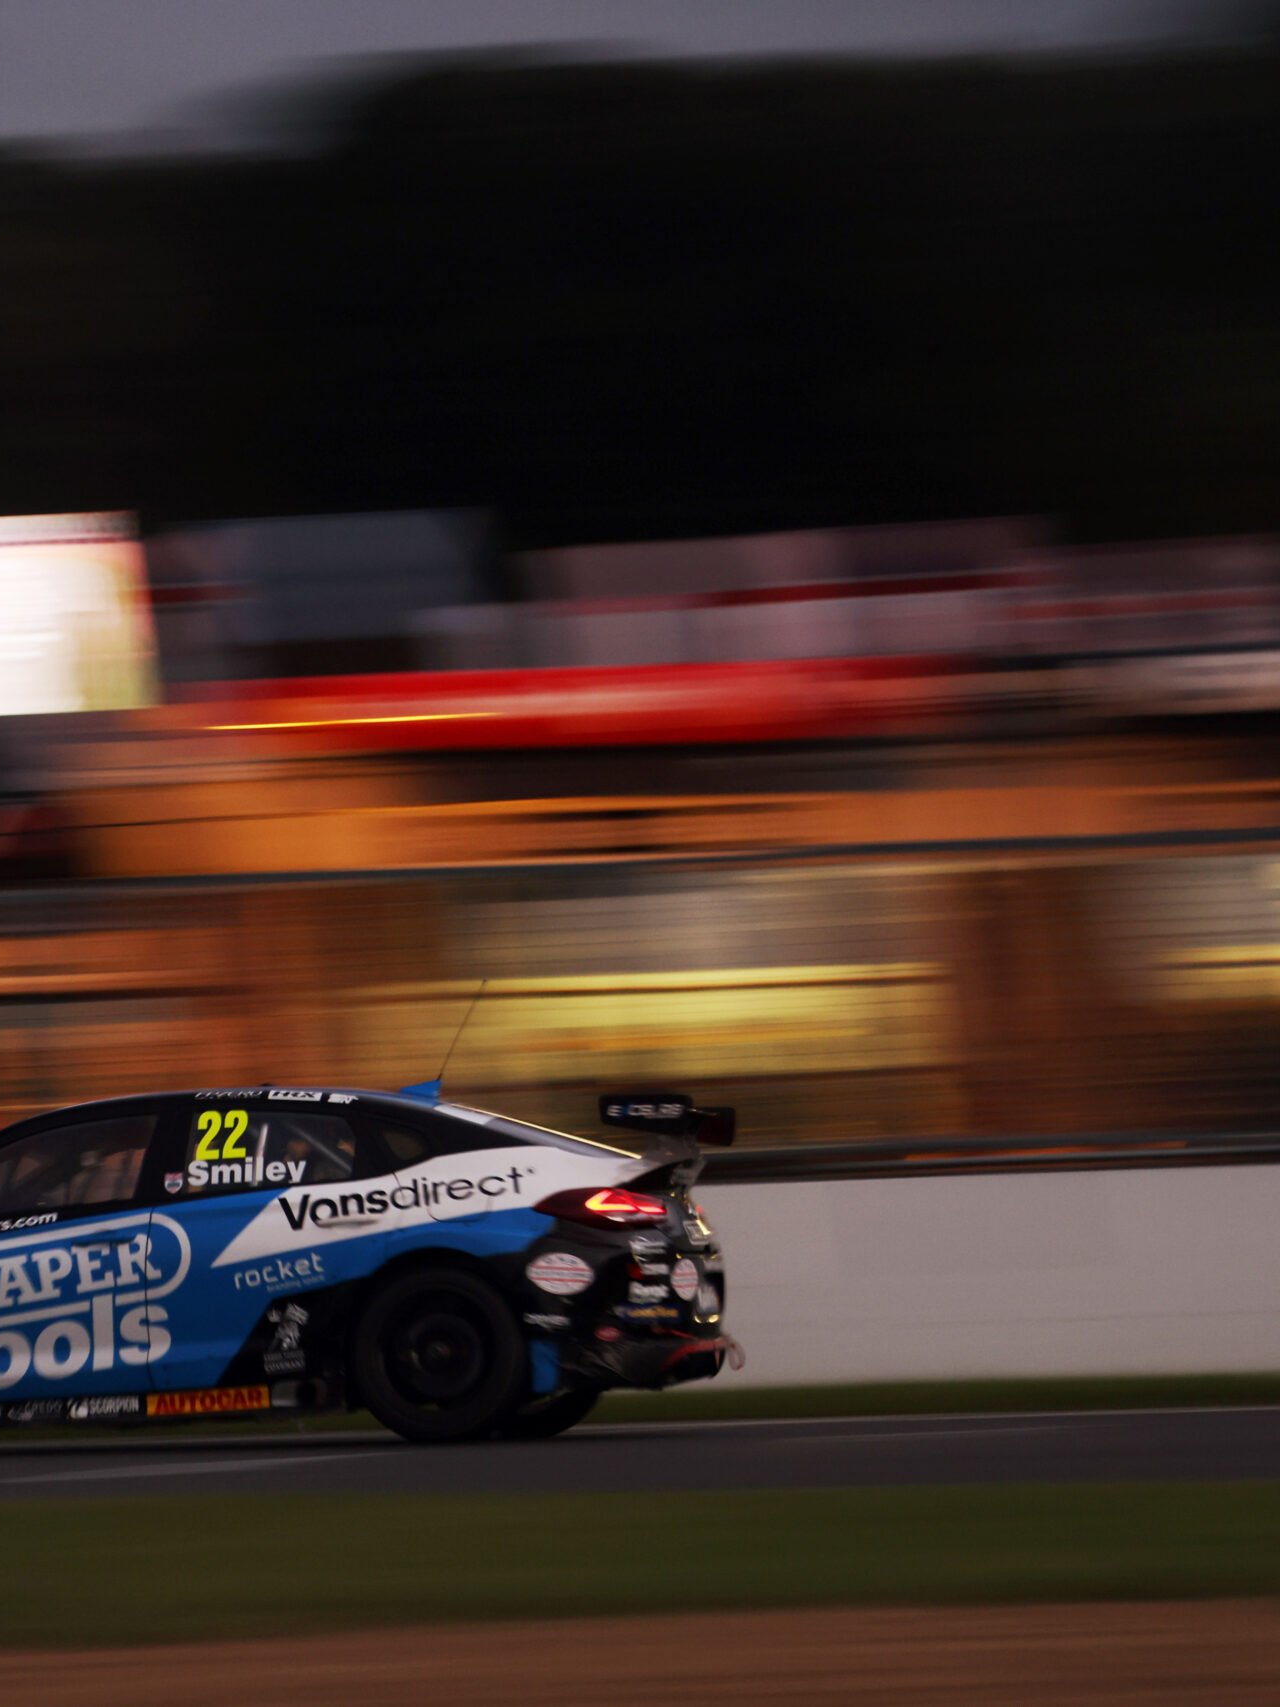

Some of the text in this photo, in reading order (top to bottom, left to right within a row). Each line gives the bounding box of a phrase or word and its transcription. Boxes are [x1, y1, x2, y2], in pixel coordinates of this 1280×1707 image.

[195, 1109, 249, 1161] 22
[187, 1156, 307, 1187] Smiley
[233, 1251, 325, 1290] rocket
[155, 1387, 264, 1414] AUTOCAR
